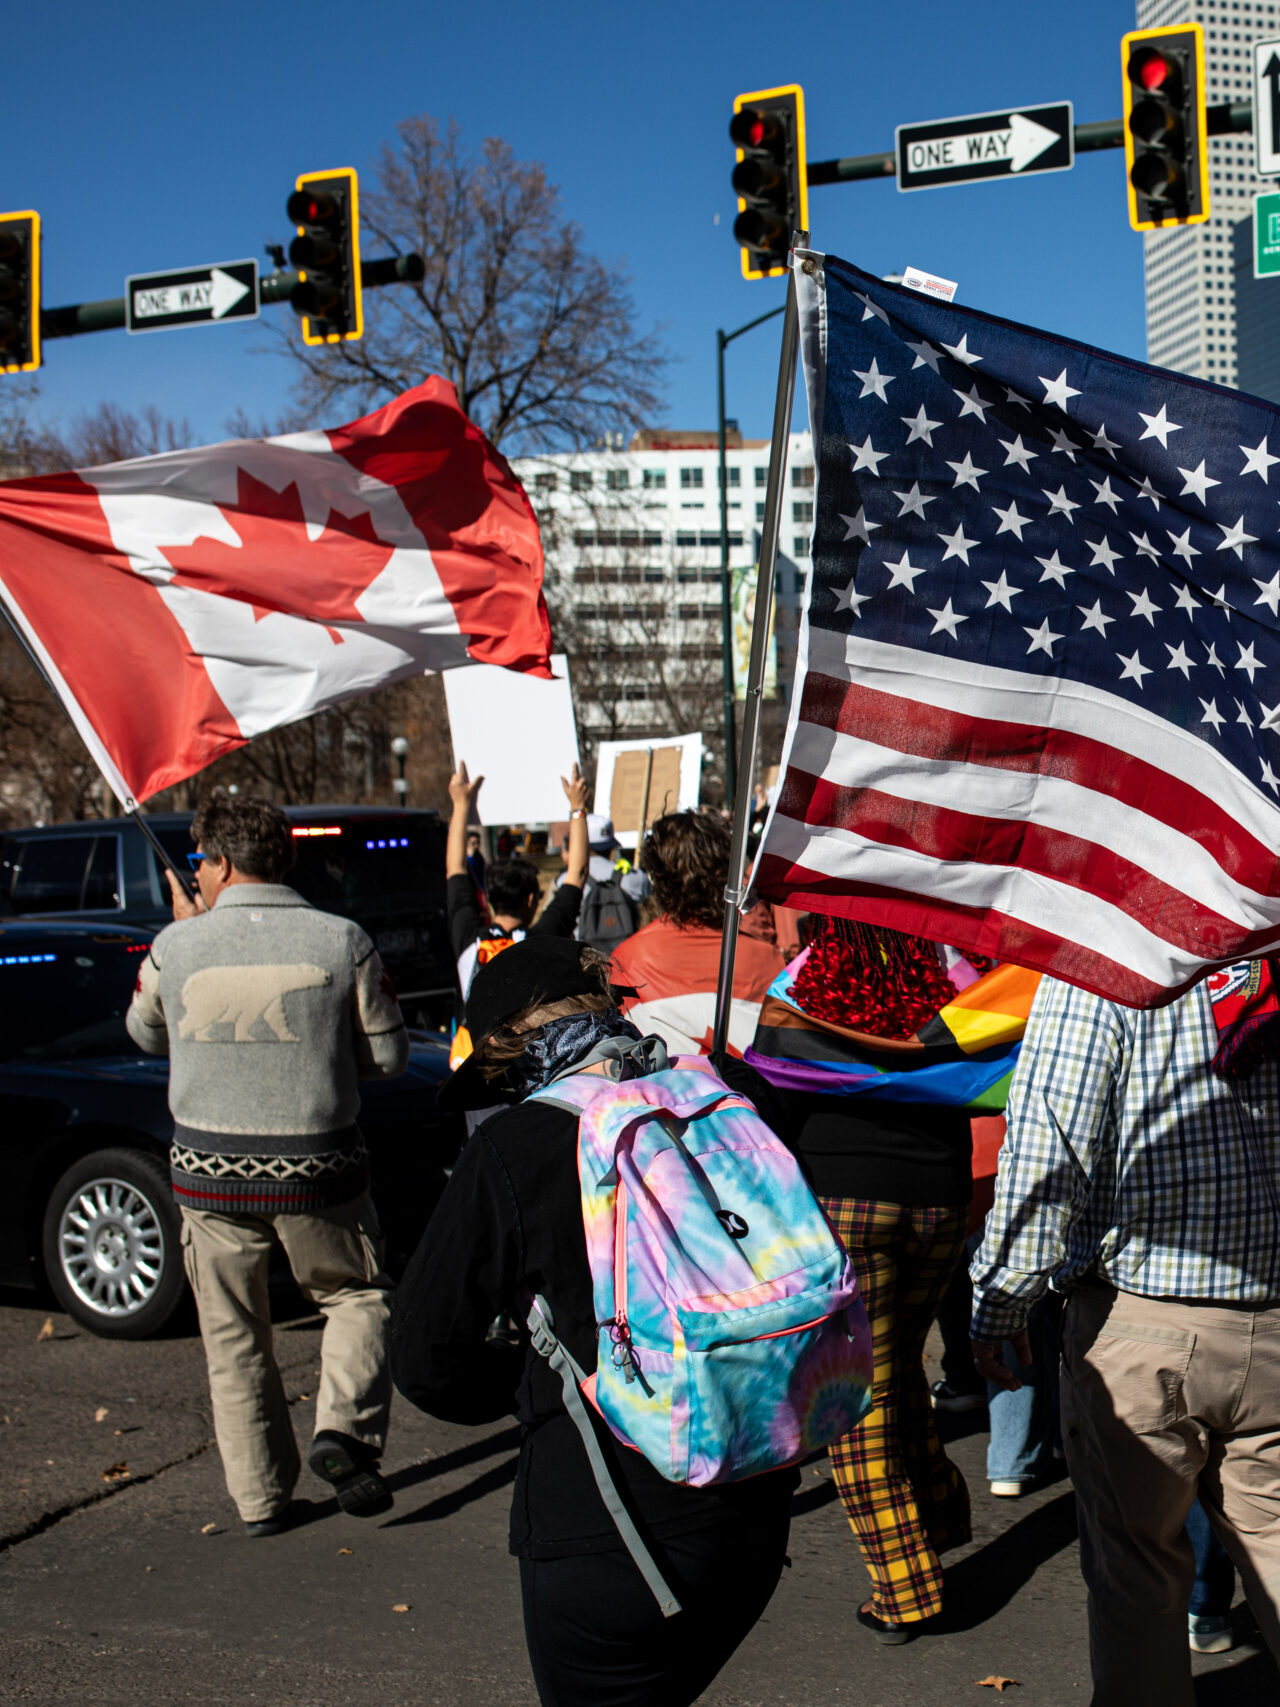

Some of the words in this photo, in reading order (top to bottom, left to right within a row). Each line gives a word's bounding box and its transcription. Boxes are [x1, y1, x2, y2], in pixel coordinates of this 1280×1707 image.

[911, 142, 953, 168] ONE
[966, 132, 1012, 161] WAY
[139, 289, 170, 314] ONE
[179, 284, 212, 308] WAY
